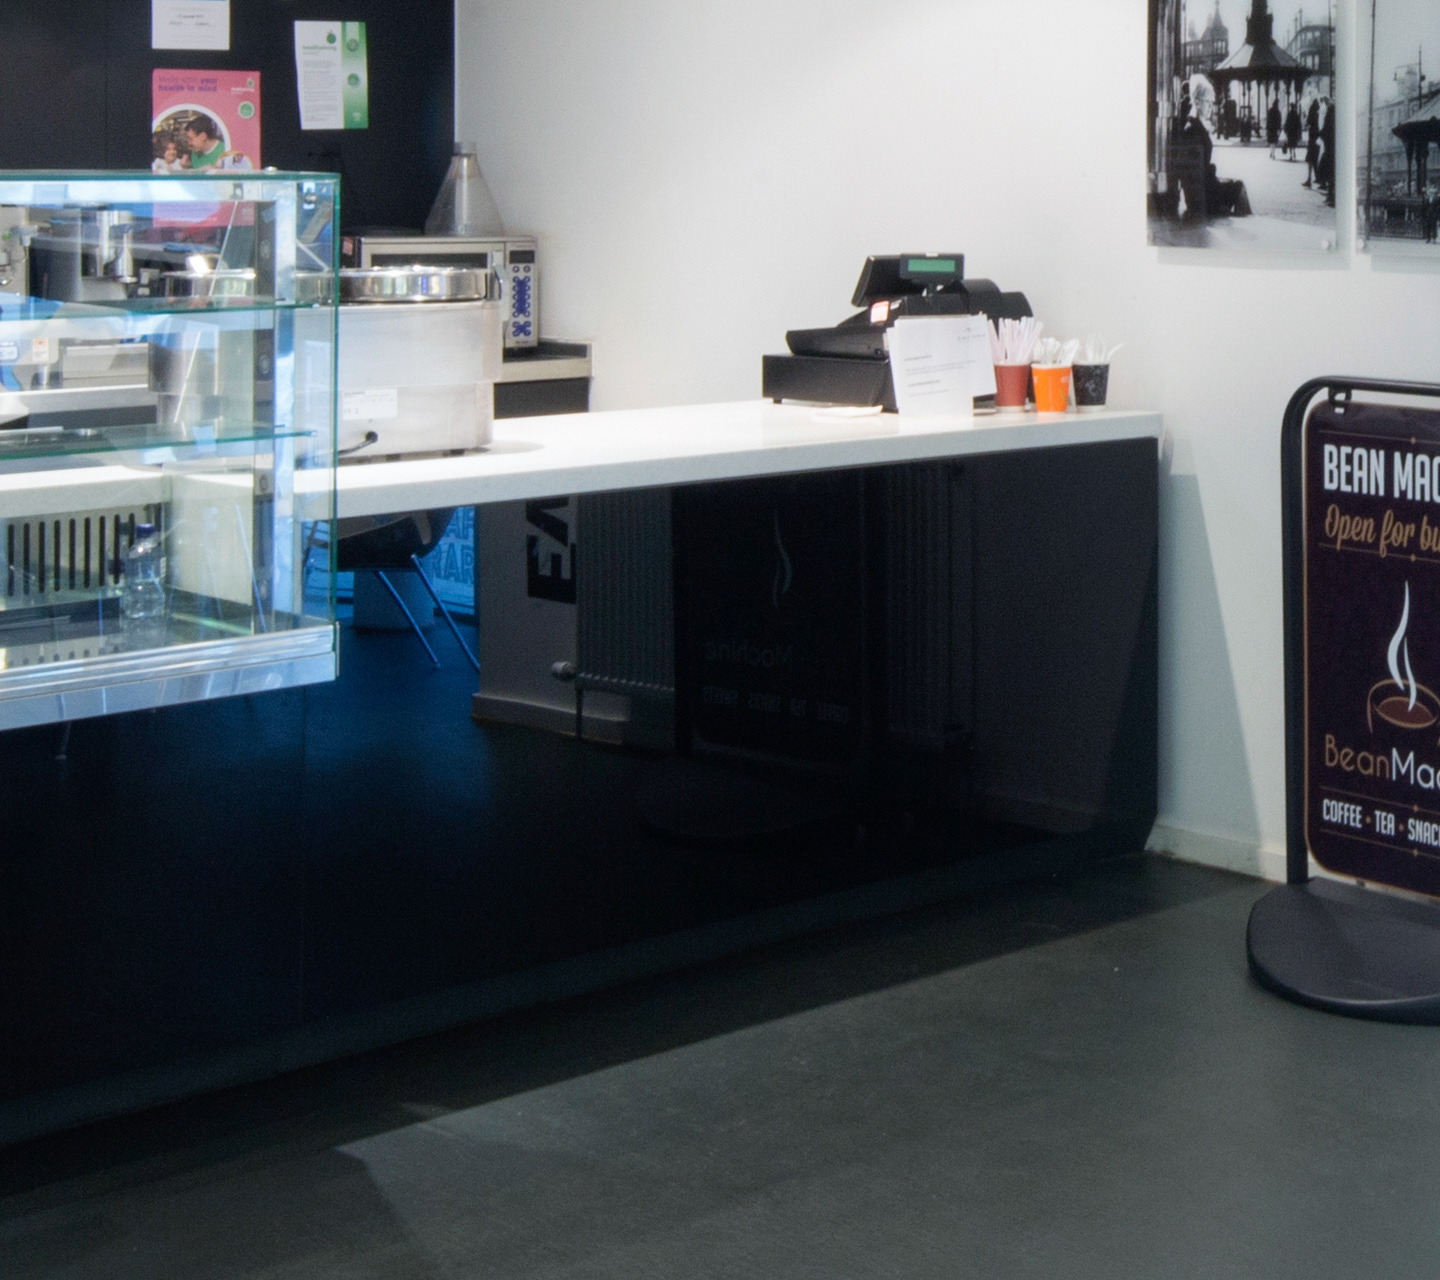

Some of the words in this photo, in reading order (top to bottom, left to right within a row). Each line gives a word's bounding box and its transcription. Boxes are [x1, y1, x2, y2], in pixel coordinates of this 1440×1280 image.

[1324, 444, 1385, 497] BEAN
[1324, 504, 1377, 551] Open
[1379, 509, 1415, 558] for
[1323, 799, 1362, 828] COFFEE
[1374, 810, 1395, 836] TEA
